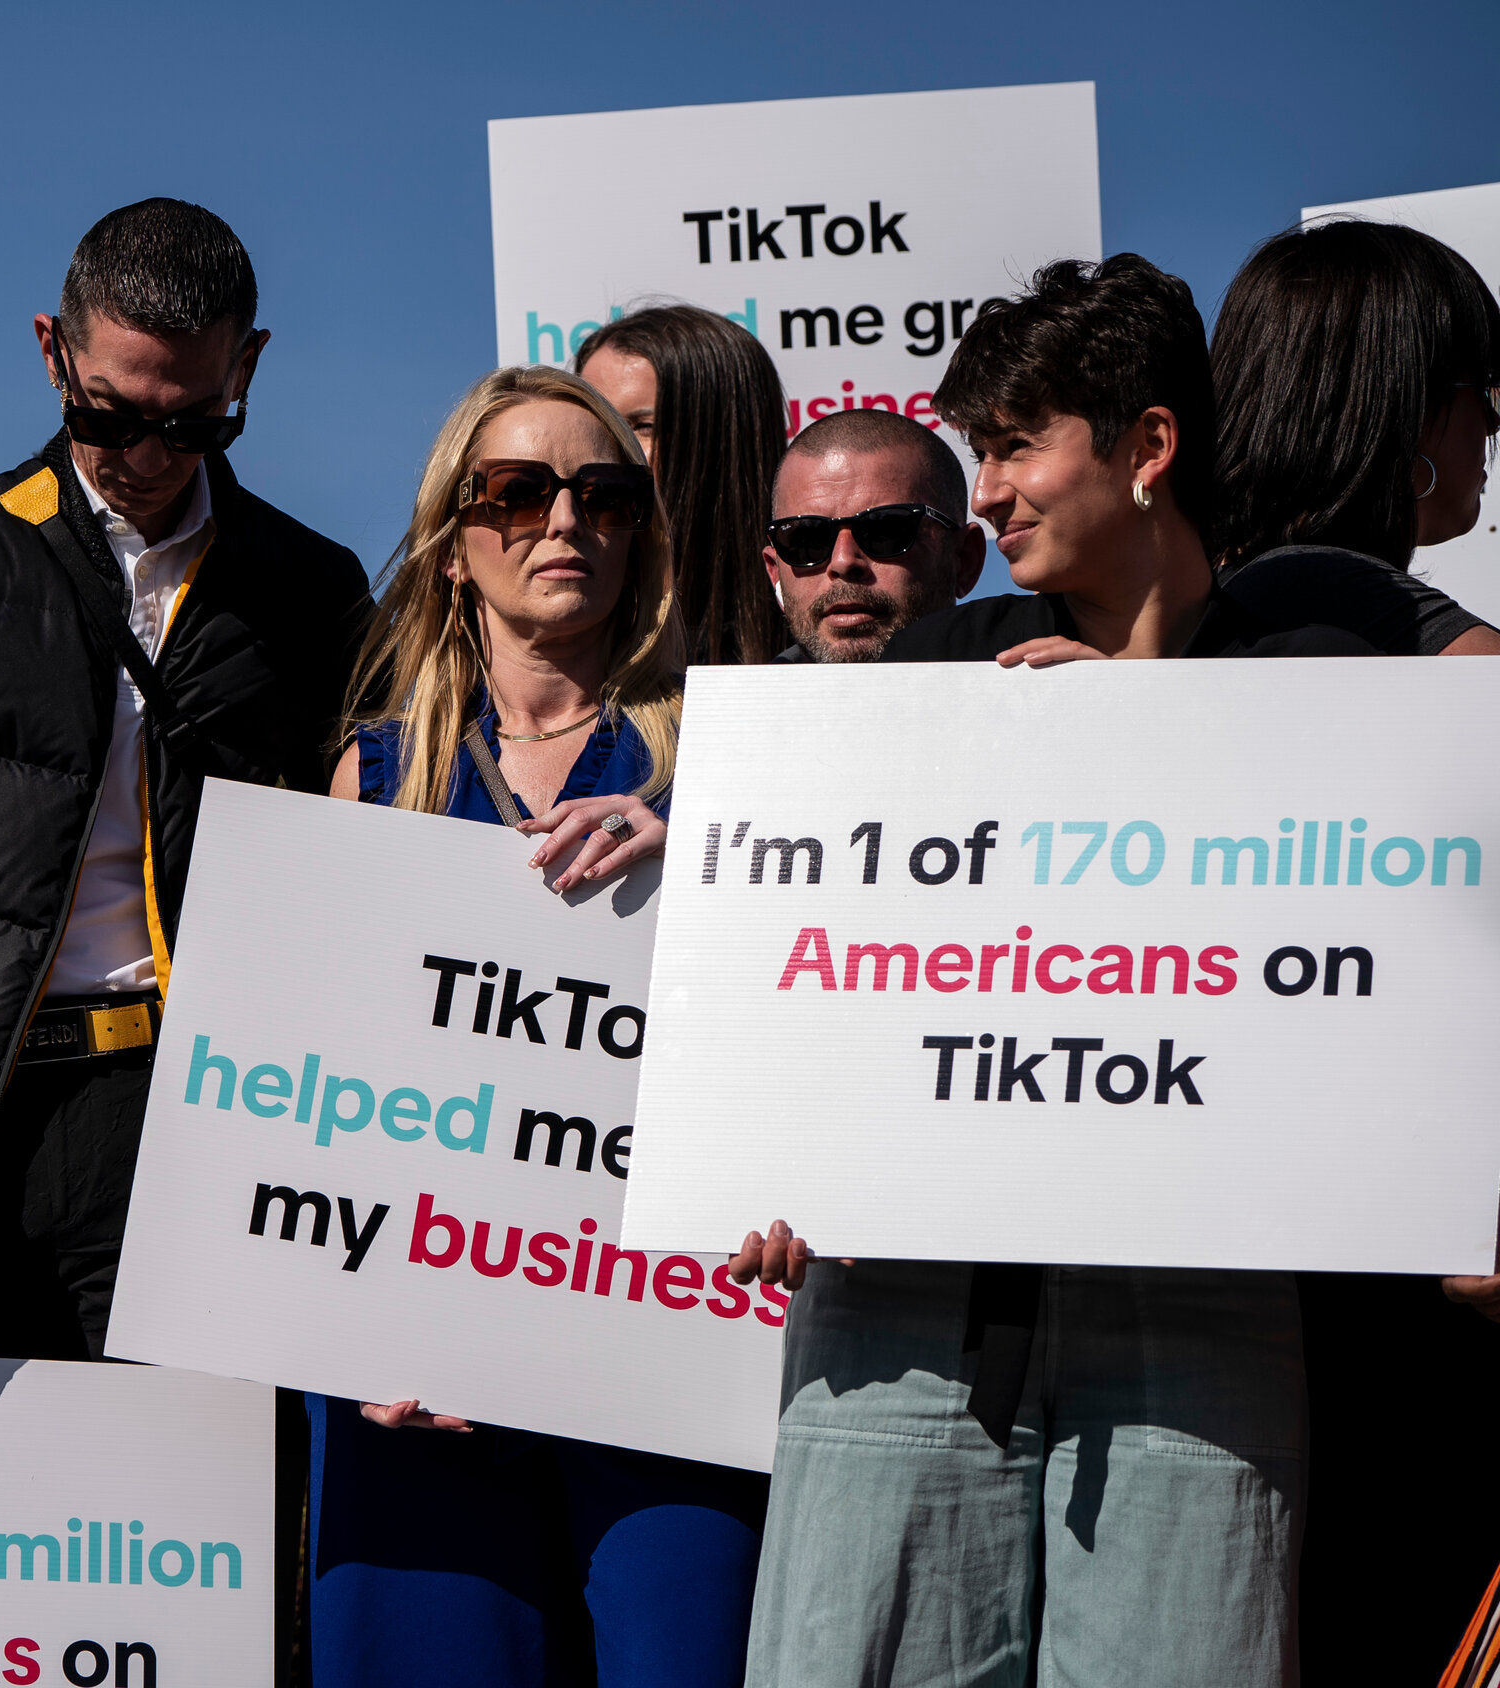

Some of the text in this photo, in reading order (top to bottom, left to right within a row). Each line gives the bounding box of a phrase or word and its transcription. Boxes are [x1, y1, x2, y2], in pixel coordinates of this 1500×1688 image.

[682, 200, 910, 265] TikTok
[780, 304, 885, 350] me
[702, 817, 1482, 887] I’m 1 of 170 million
[777, 925, 1374, 997] Americans on
[25, 1023, 78, 1048] FENDI
[423, 954, 647, 1060] TikTo
[922, 1032, 1206, 1106] TikTok
[184, 1034, 634, 1180] helped me
[248, 1182, 390, 1273] my
[62, 1639, 157, 1688] on
